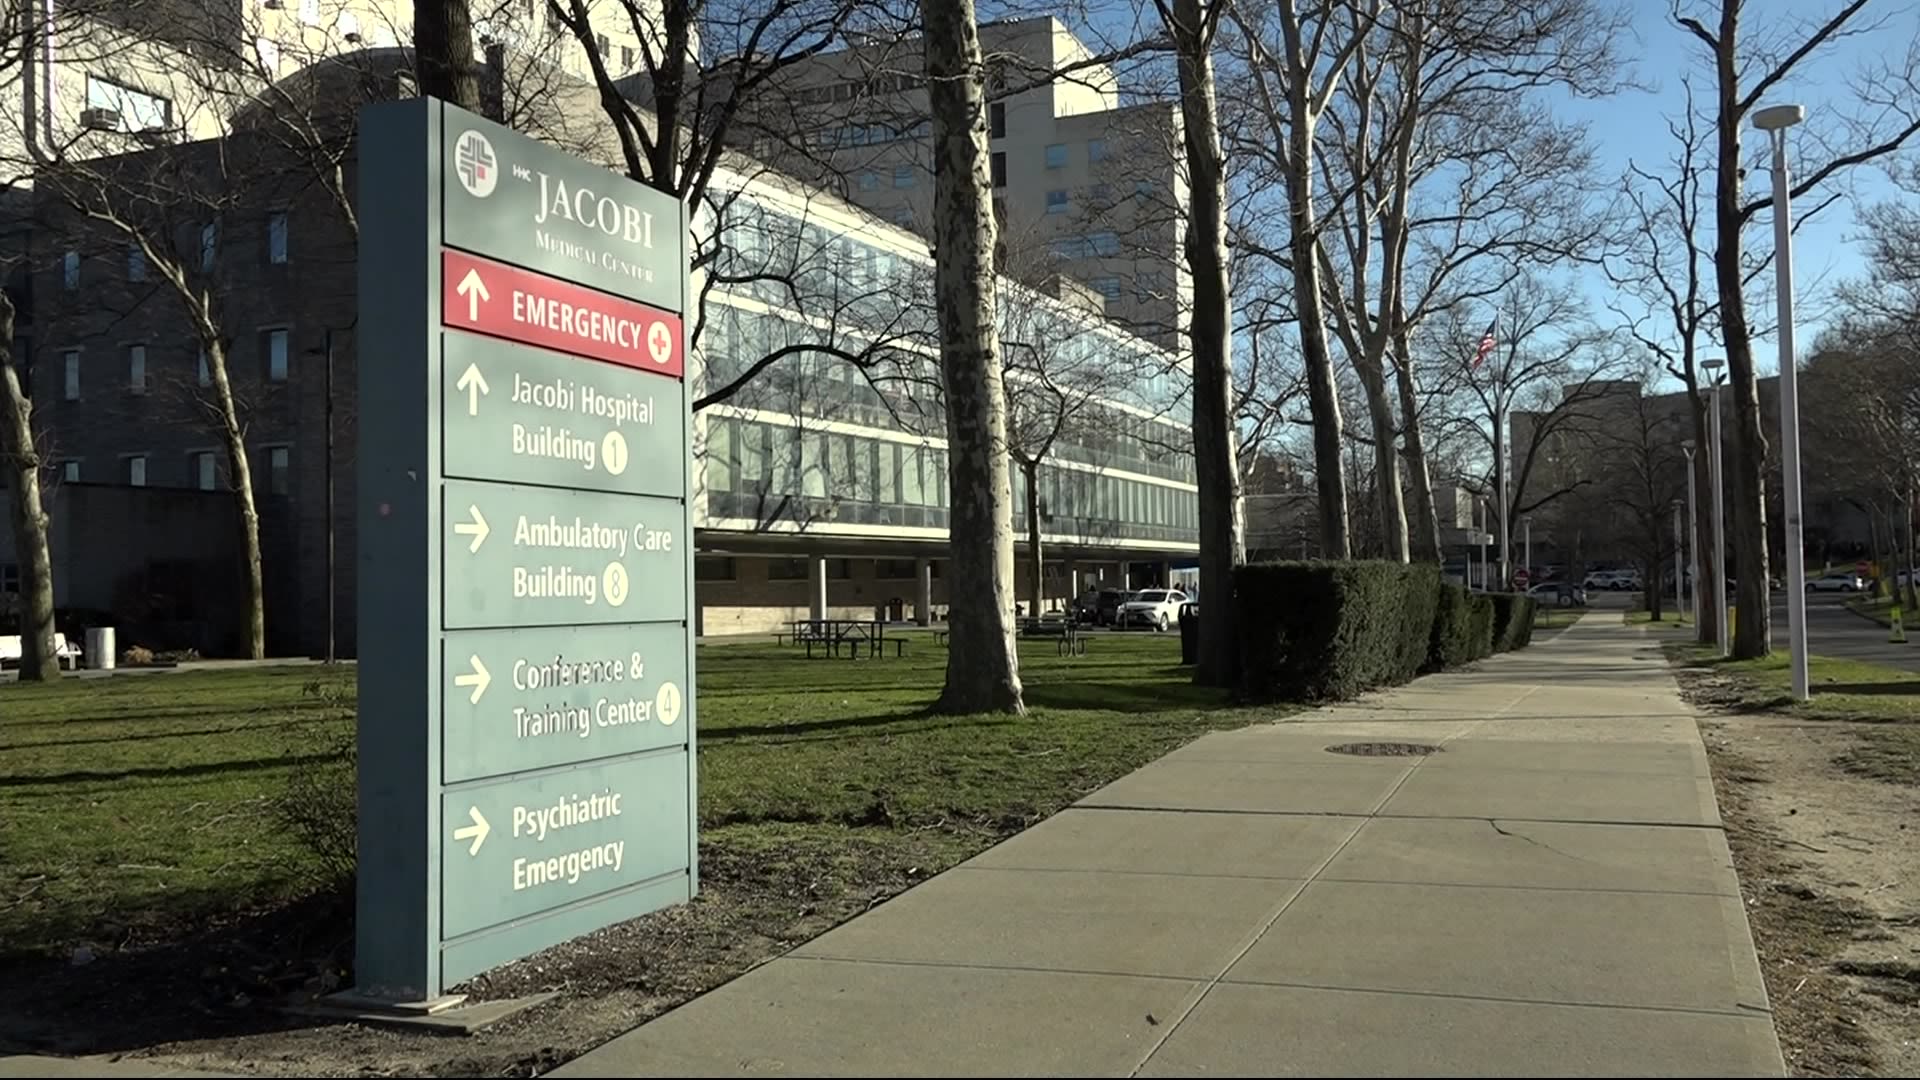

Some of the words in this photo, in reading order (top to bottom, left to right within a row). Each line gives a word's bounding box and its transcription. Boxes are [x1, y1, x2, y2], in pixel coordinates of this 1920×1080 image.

[535, 171, 654, 249] JACOBI
[512, 289, 642, 350] EMERGENCY
[511, 372, 575, 412] Jacobi
[581, 385, 654, 426] Hospital
[512, 423, 596, 471] Building
[513, 515, 628, 557] Ambulatory
[633, 522, 672, 552] Care
[513, 566, 597, 605] Building
[512, 654, 625, 691] Conference
[629, 651, 644, 681] &
[512, 701, 591, 738] Training
[595, 697, 654, 728] Center
[512, 787, 622, 841] Psychiatric
[512, 840, 625, 891] Emergency
